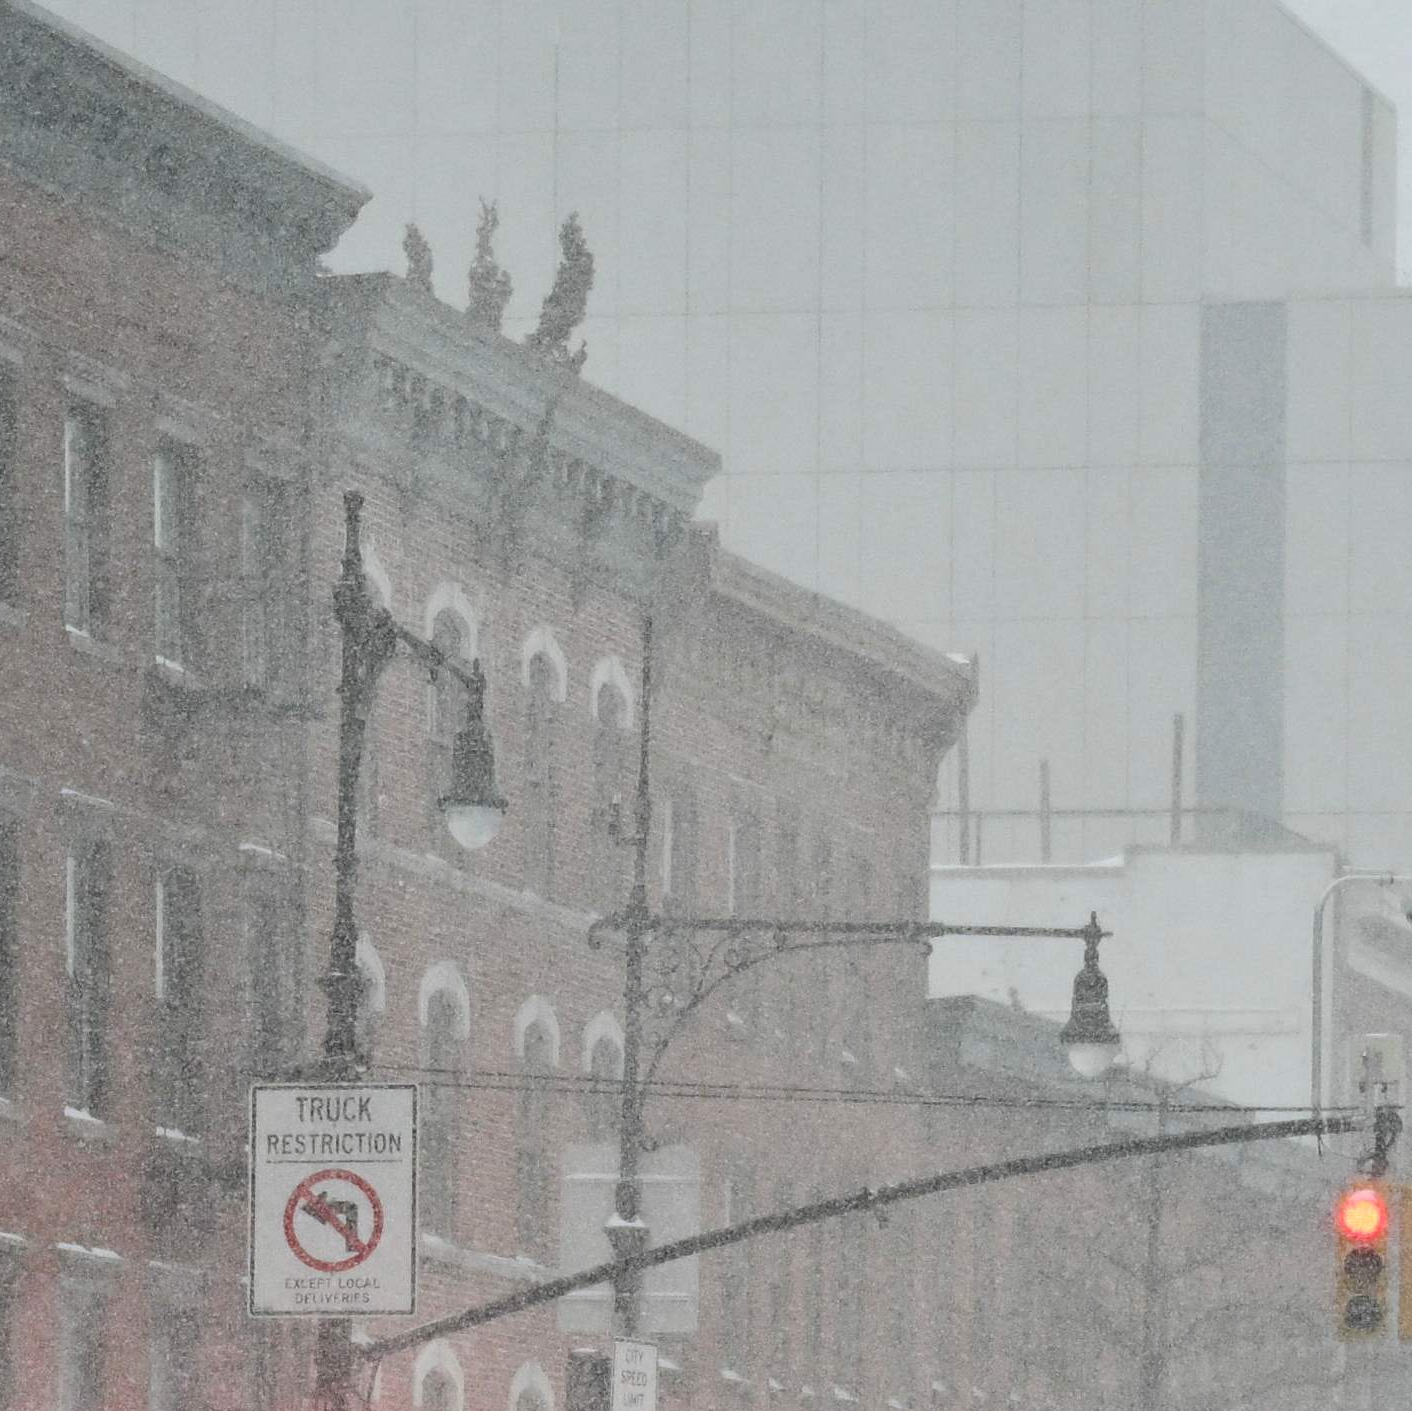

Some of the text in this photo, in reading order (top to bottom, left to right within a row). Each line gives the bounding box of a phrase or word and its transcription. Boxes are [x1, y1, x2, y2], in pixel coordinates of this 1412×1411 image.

[295, 1096, 373, 1122] TRUCK
[266, 1132, 402, 1155] RESTRICTION
[284, 1277, 381, 1290] EXCEPT LOCAL
[294, 1292, 370, 1305] DELIVERIES
[620, 1371, 648, 1387] SPEED
[622, 1393, 645, 1408] LIMIT
